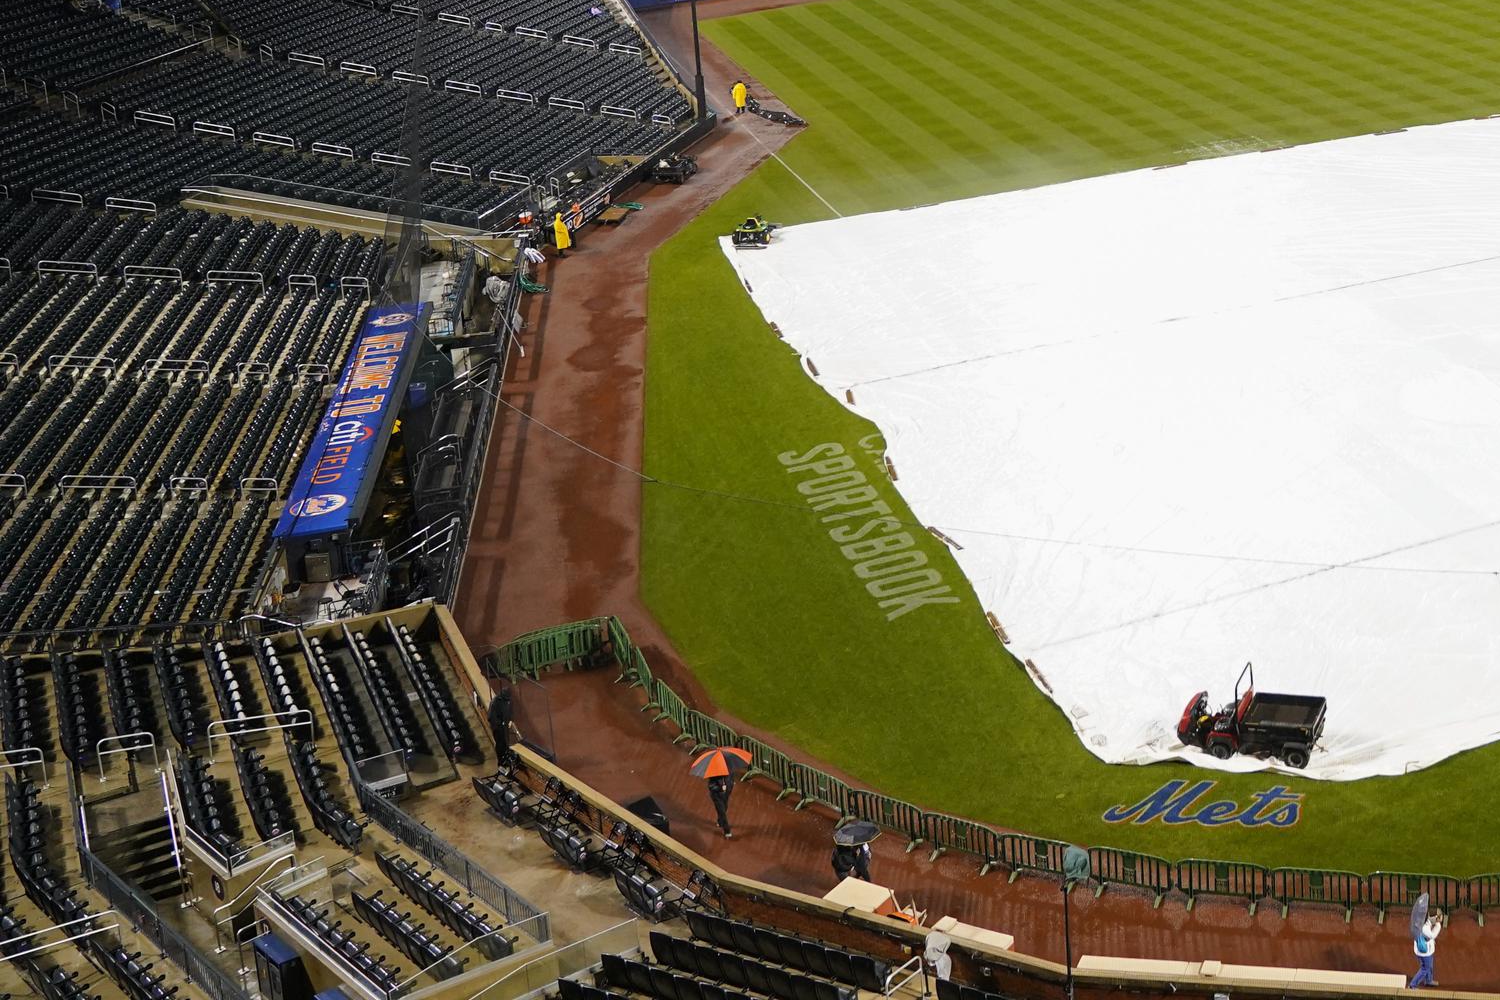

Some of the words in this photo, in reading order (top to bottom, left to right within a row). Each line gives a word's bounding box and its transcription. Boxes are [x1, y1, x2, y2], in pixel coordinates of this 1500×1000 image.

[341, 331, 409, 394] WELCOME
[331, 395, 385, 417] TO
[311, 446, 352, 485] FIELD
[777, 442, 960, 622] SPORTSBOOK
[1102, 779, 1305, 828] Mets
